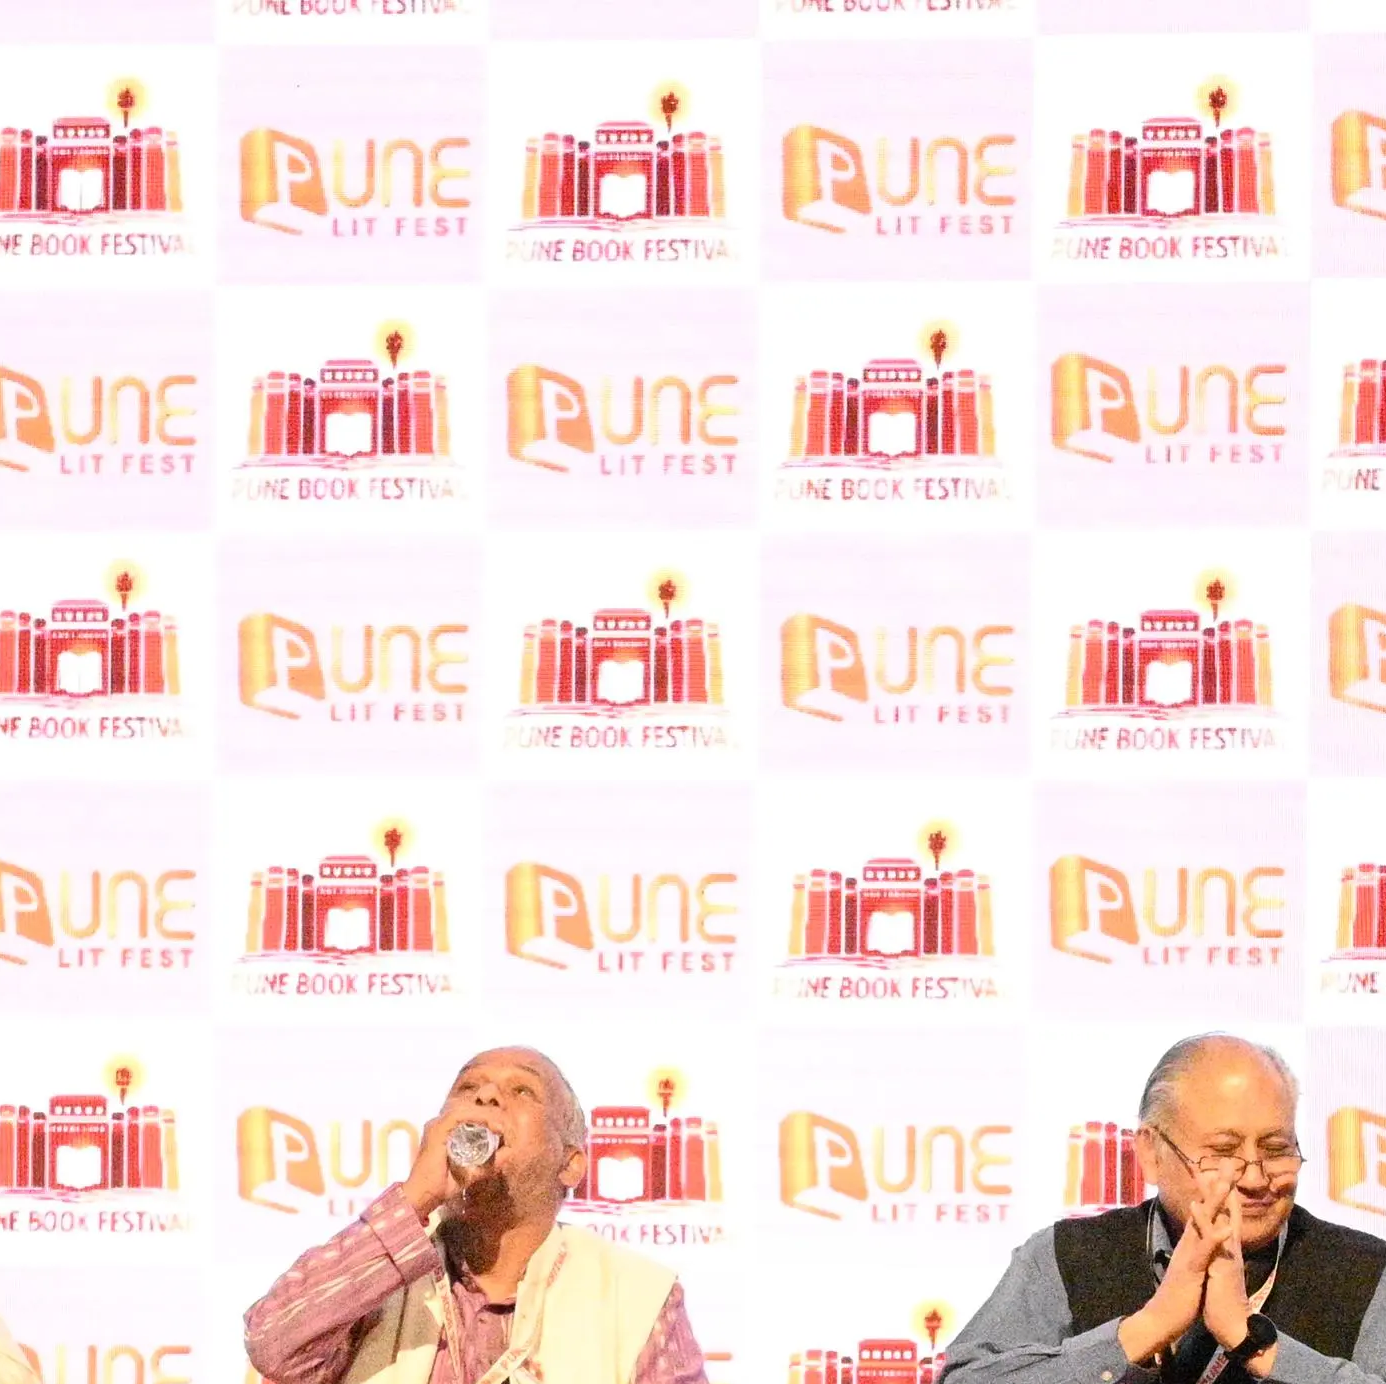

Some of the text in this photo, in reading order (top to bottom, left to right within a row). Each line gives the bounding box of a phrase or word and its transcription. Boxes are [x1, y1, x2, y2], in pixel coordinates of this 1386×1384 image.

[60, 453, 194, 475] LIT FEST
[781, 614, 1015, 709] PUNE
[875, 705, 1009, 724] LIT FEST
